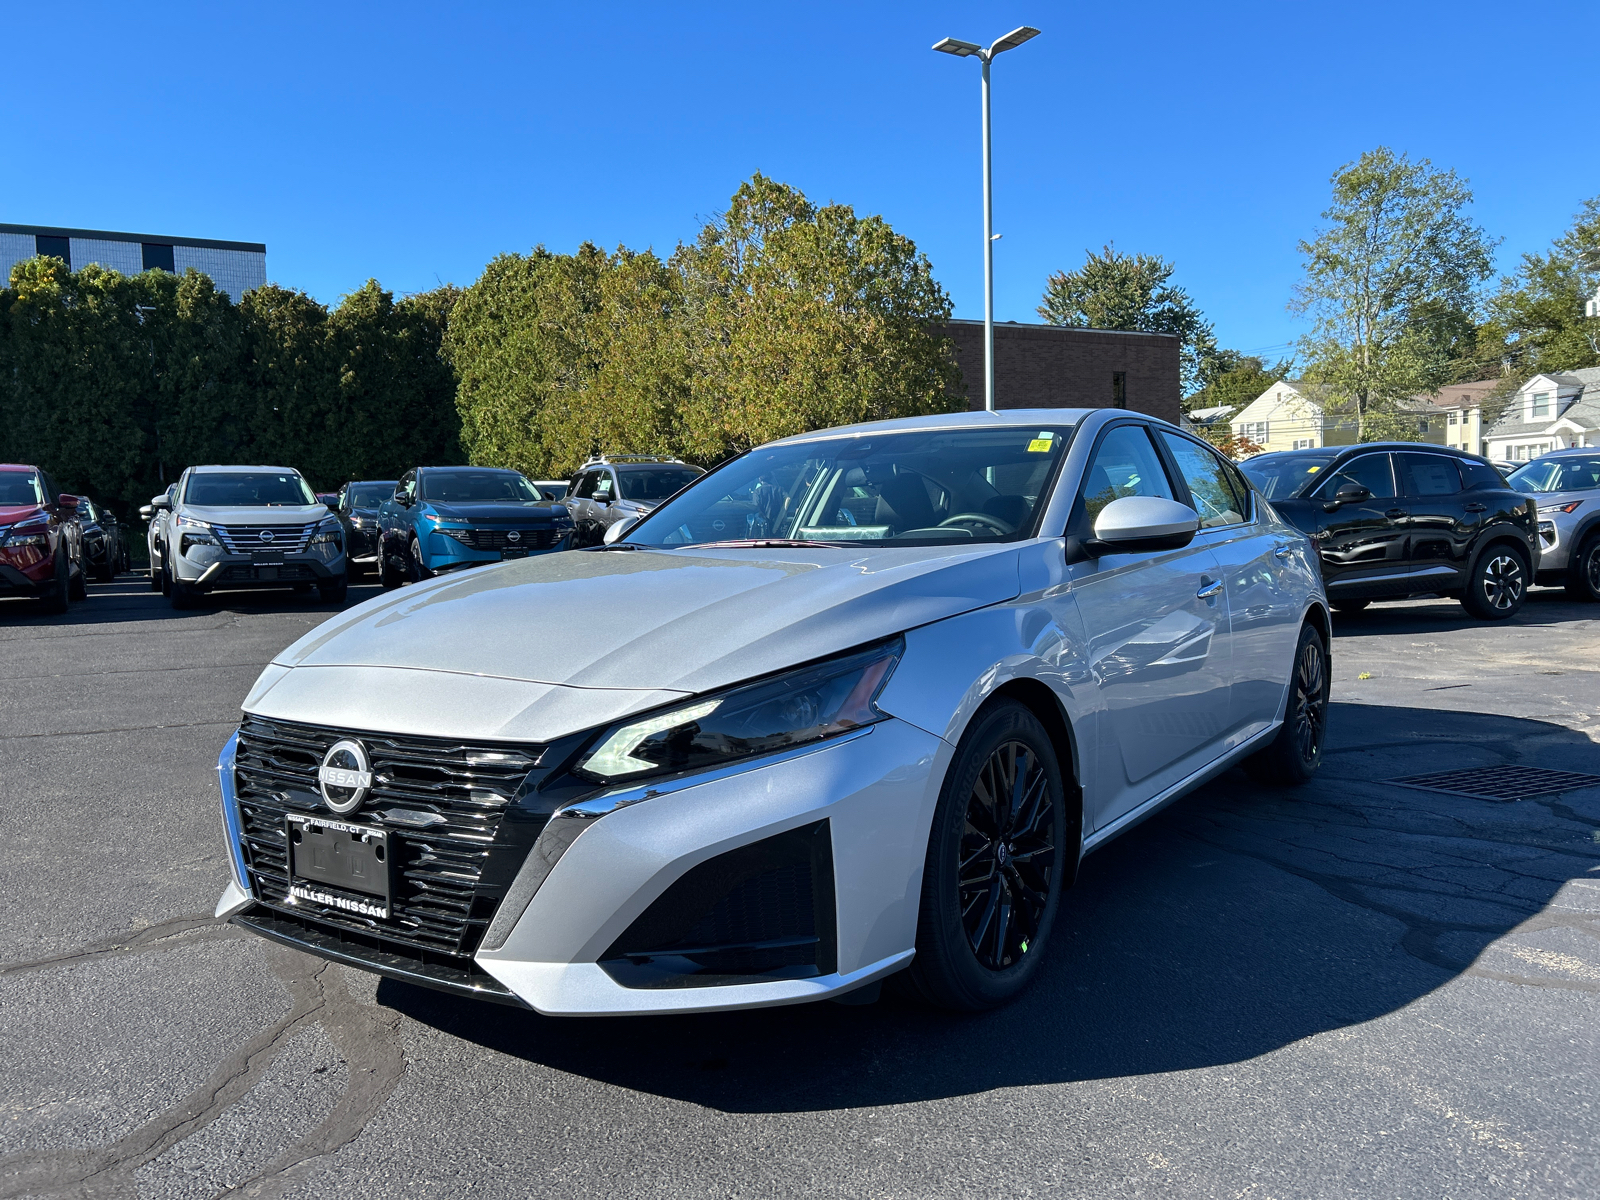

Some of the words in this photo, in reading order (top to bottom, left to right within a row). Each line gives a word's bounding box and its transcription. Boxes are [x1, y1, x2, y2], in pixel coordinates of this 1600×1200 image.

[319, 768, 369, 786] NISSAN
[310, 818, 348, 832] FAIRFIELD,
[349, 826, 360, 834] CT
[290, 885, 334, 906] MILLER
[336, 897, 387, 919] NISSAN
